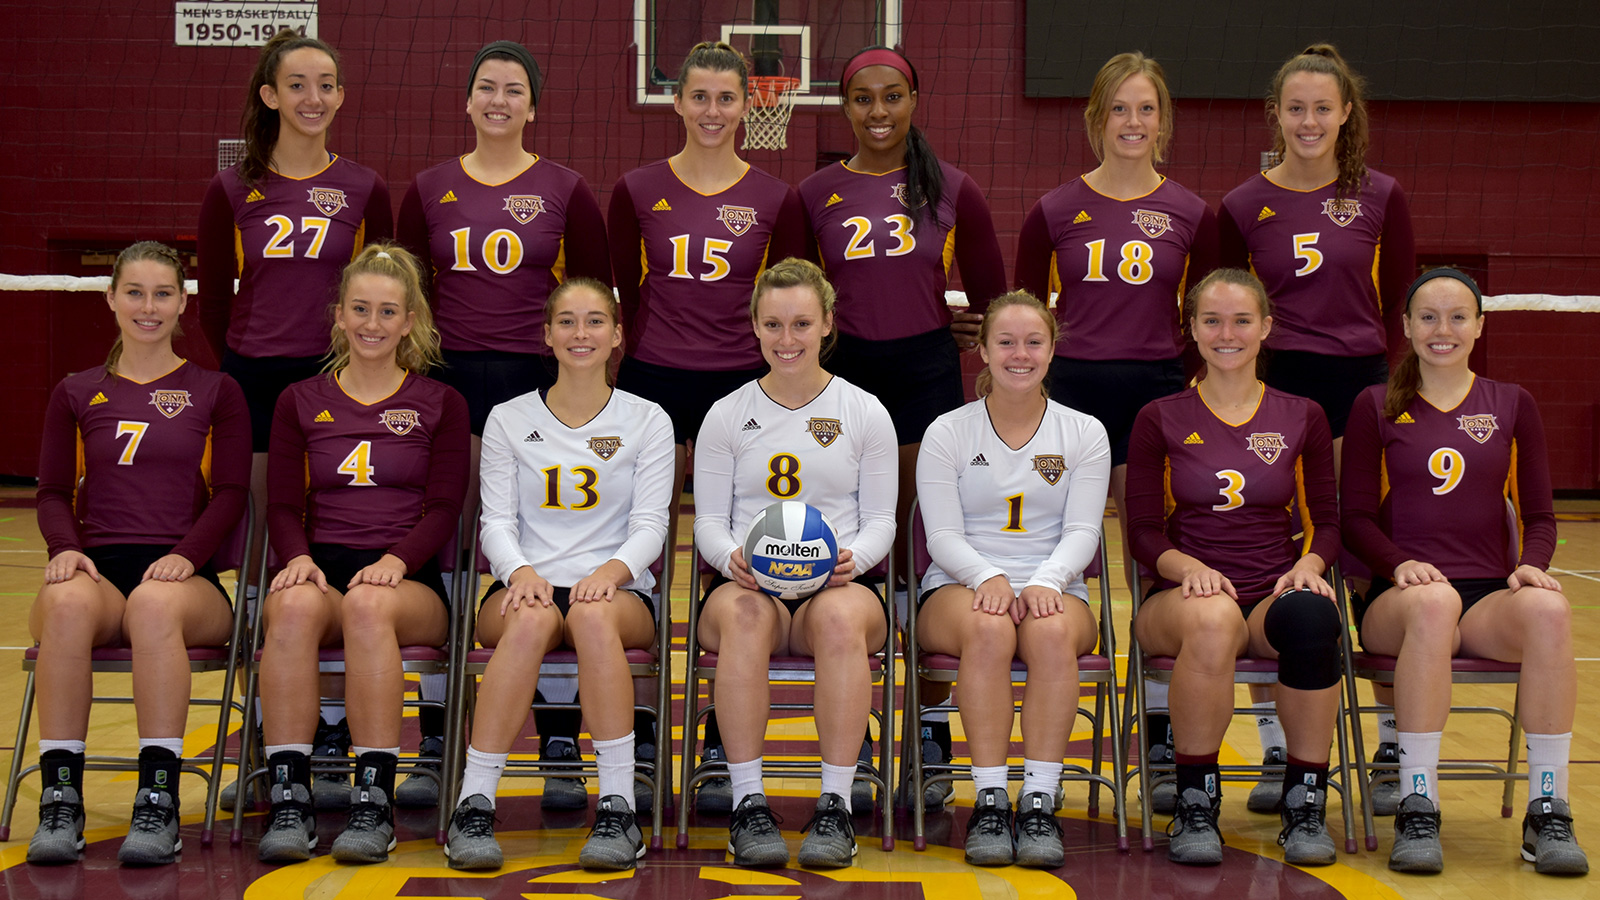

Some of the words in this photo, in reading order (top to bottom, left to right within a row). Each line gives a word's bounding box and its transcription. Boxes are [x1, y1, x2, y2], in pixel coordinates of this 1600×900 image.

[183, 8, 222, 19] MEN'S
[226, 9, 311, 20] BASKETBALL
[312, 191, 344, 205] IONA
[508, 199, 542, 211] IONA
[721, 210, 754, 223] IONA
[1136, 214, 1169, 228] IONA
[262, 214, 332, 259] 27
[841, 213, 917, 261] 23
[449, 226, 524, 275] 10
[667, 233, 734, 282] 15
[1292, 232, 1324, 277] 5
[1082, 238, 1154, 285] 18
[154, 394, 188, 404] IONA
[384, 413, 418, 424] IONA
[1462, 418, 1495, 429] IONA
[808, 420, 842, 433] IONA
[115, 420, 150, 466] 7
[589, 439, 622, 449] IONA
[1251, 437, 1283, 448] IONA
[336, 440, 378, 486] 4
[1034, 459, 1066, 471] IONA
[765, 451, 803, 500] 8
[1427, 446, 1466, 496] 9
[539, 463, 601, 512] 13
[1212, 469, 1246, 512] 3
[1000, 491, 1028, 533] 1
[765, 543, 820, 558] molten
[768, 561, 813, 577] NCAA
[764, 579, 788, 590] Super
